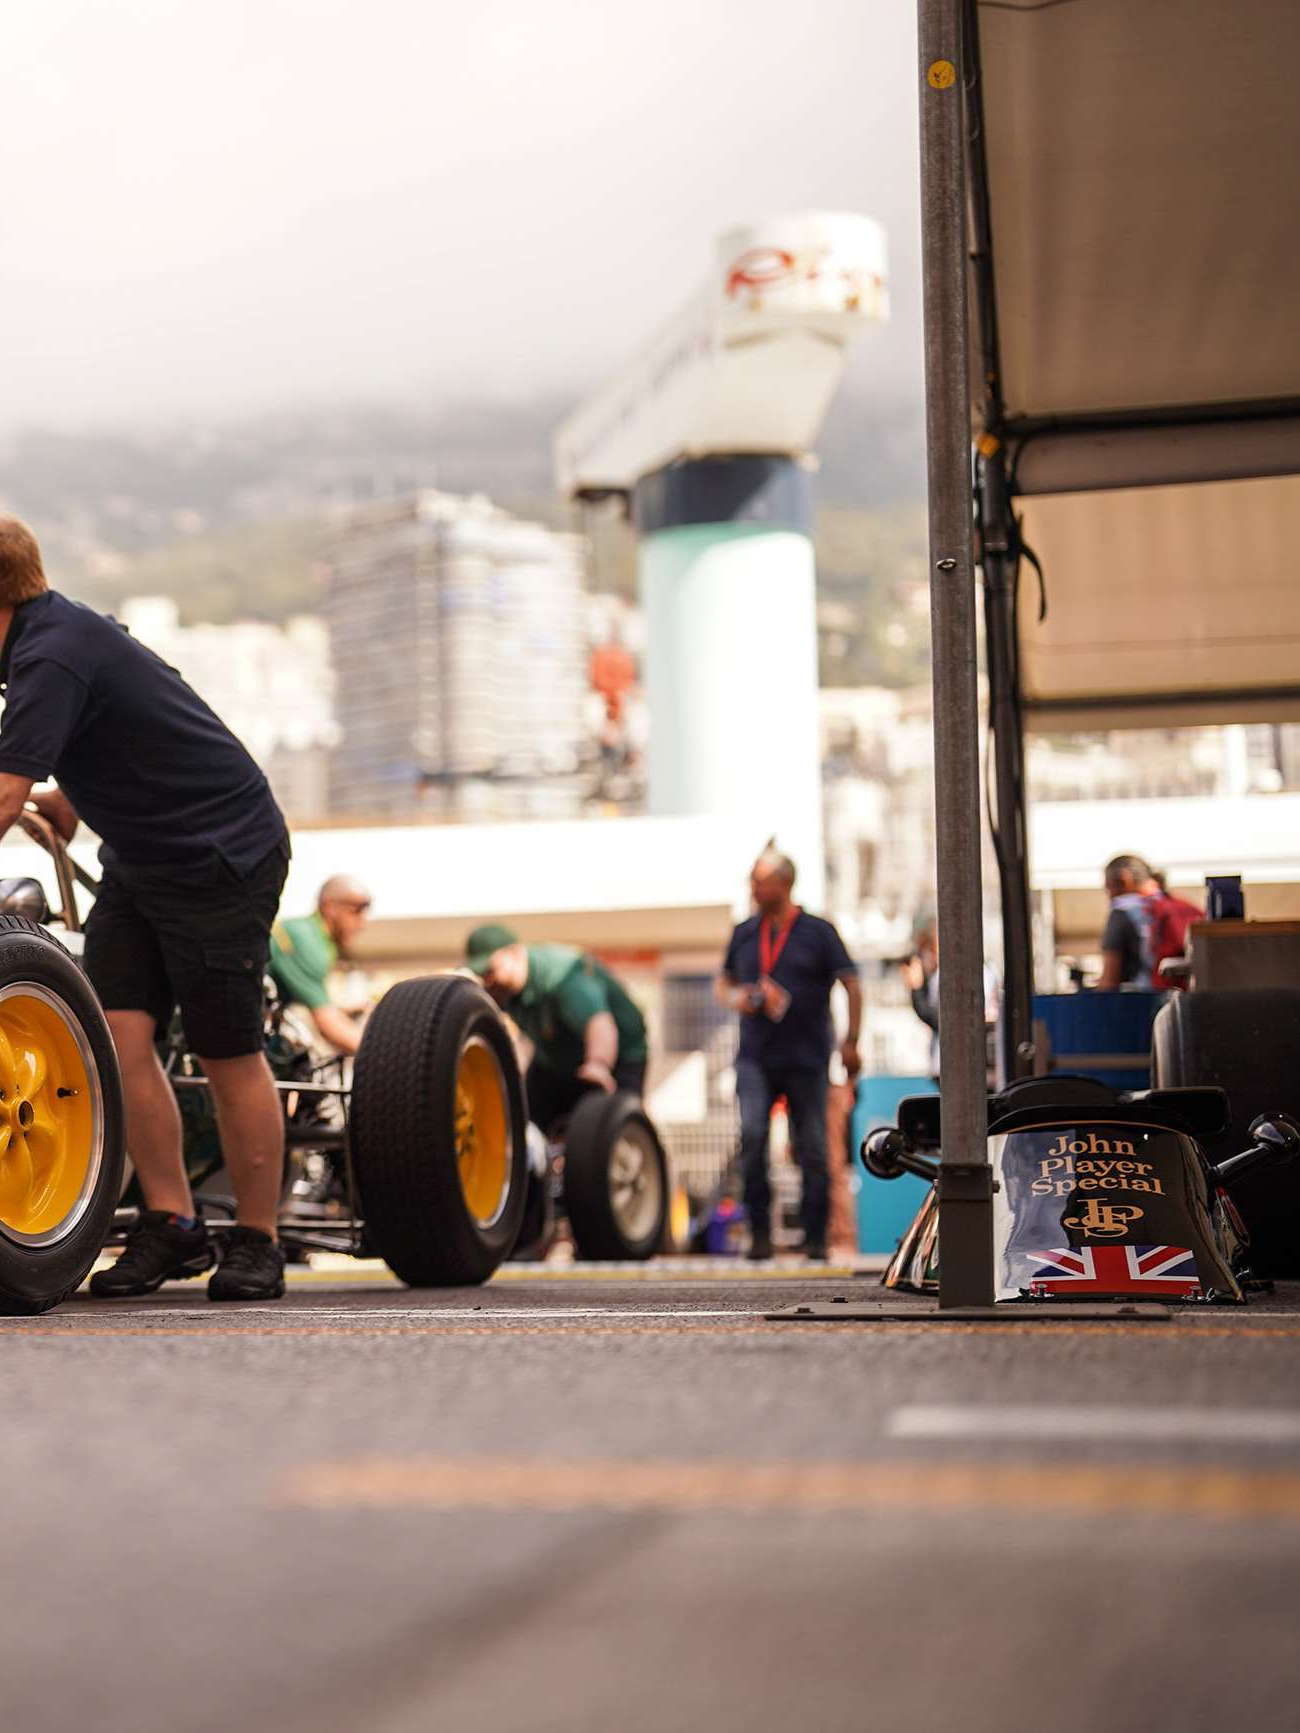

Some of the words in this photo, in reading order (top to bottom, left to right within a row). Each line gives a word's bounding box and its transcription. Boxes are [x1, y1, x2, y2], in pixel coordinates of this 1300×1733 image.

[1048, 1133, 1137, 1156] John
[1038, 1156, 1154, 1177] Player
[1031, 1174, 1166, 1198] Special
